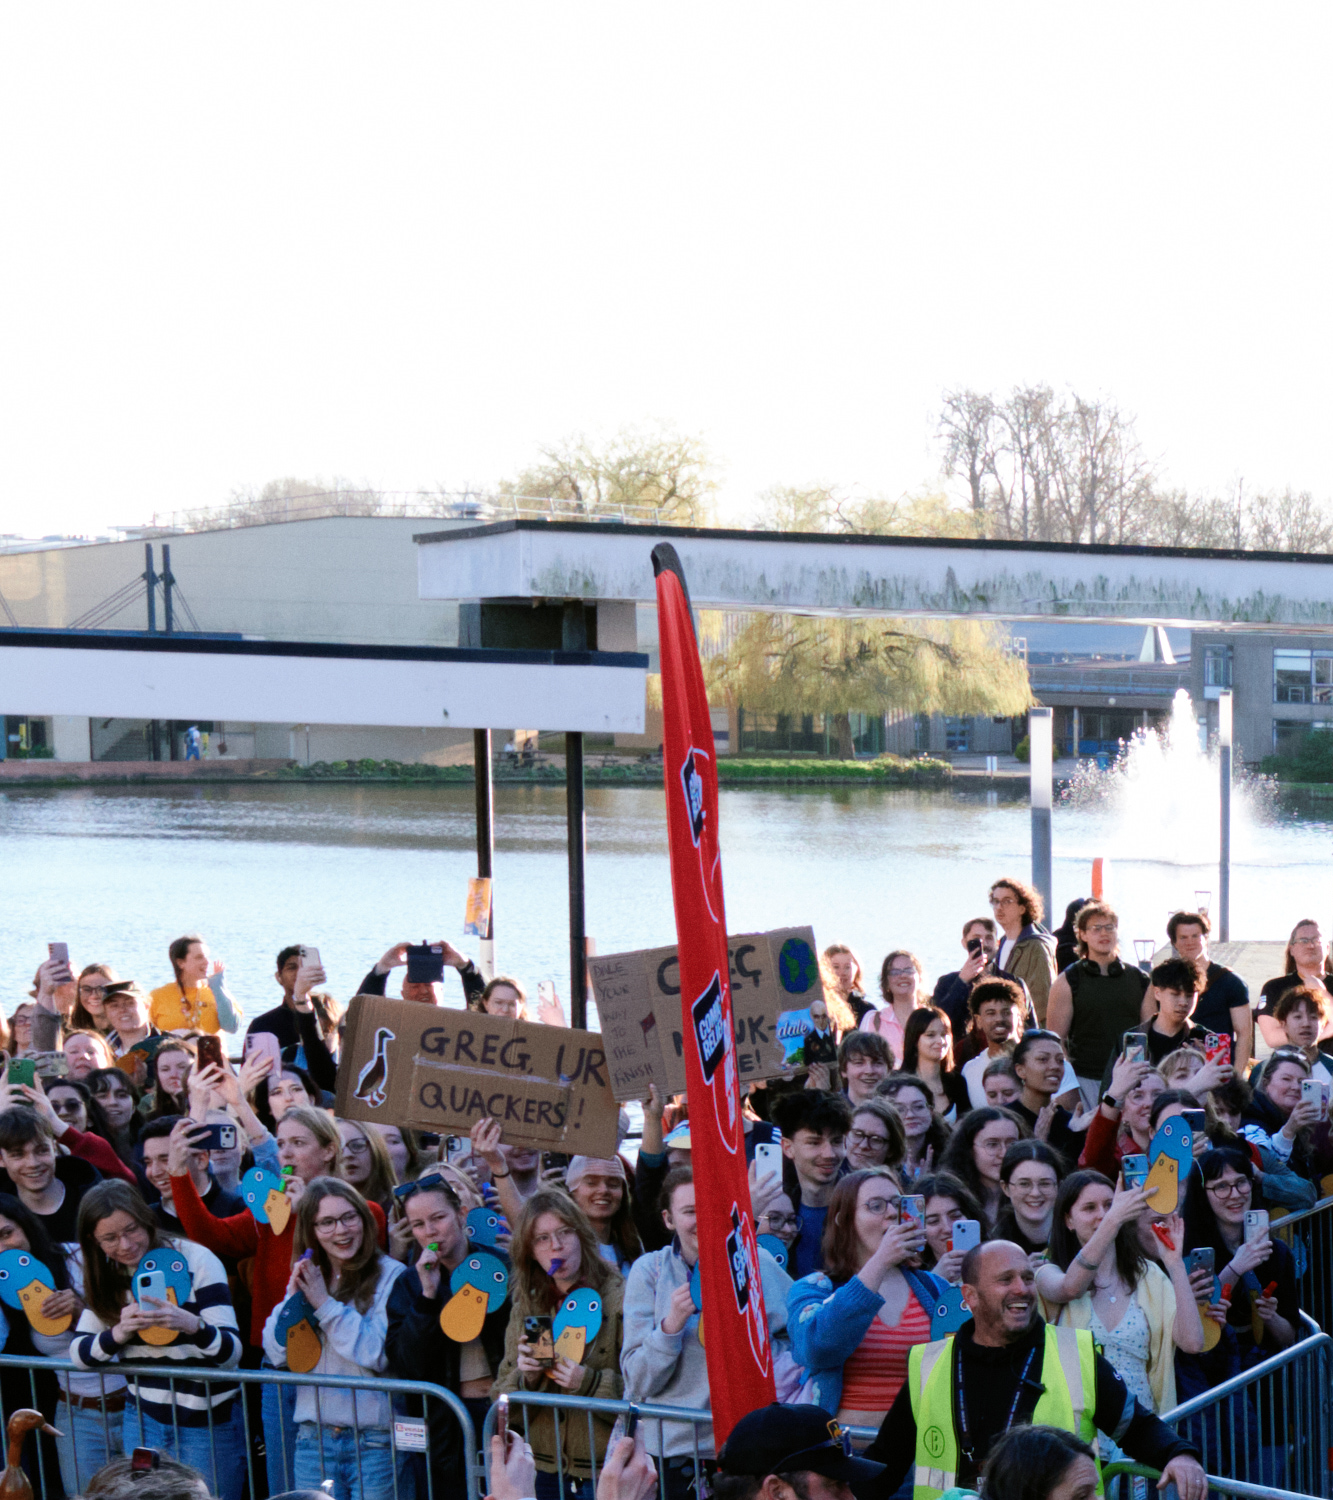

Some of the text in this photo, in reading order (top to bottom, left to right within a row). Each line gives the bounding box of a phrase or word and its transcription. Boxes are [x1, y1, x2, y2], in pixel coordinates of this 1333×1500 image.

[778, 1018, 808, 1039] dale
[420, 1026, 607, 1087] GREG, UR
